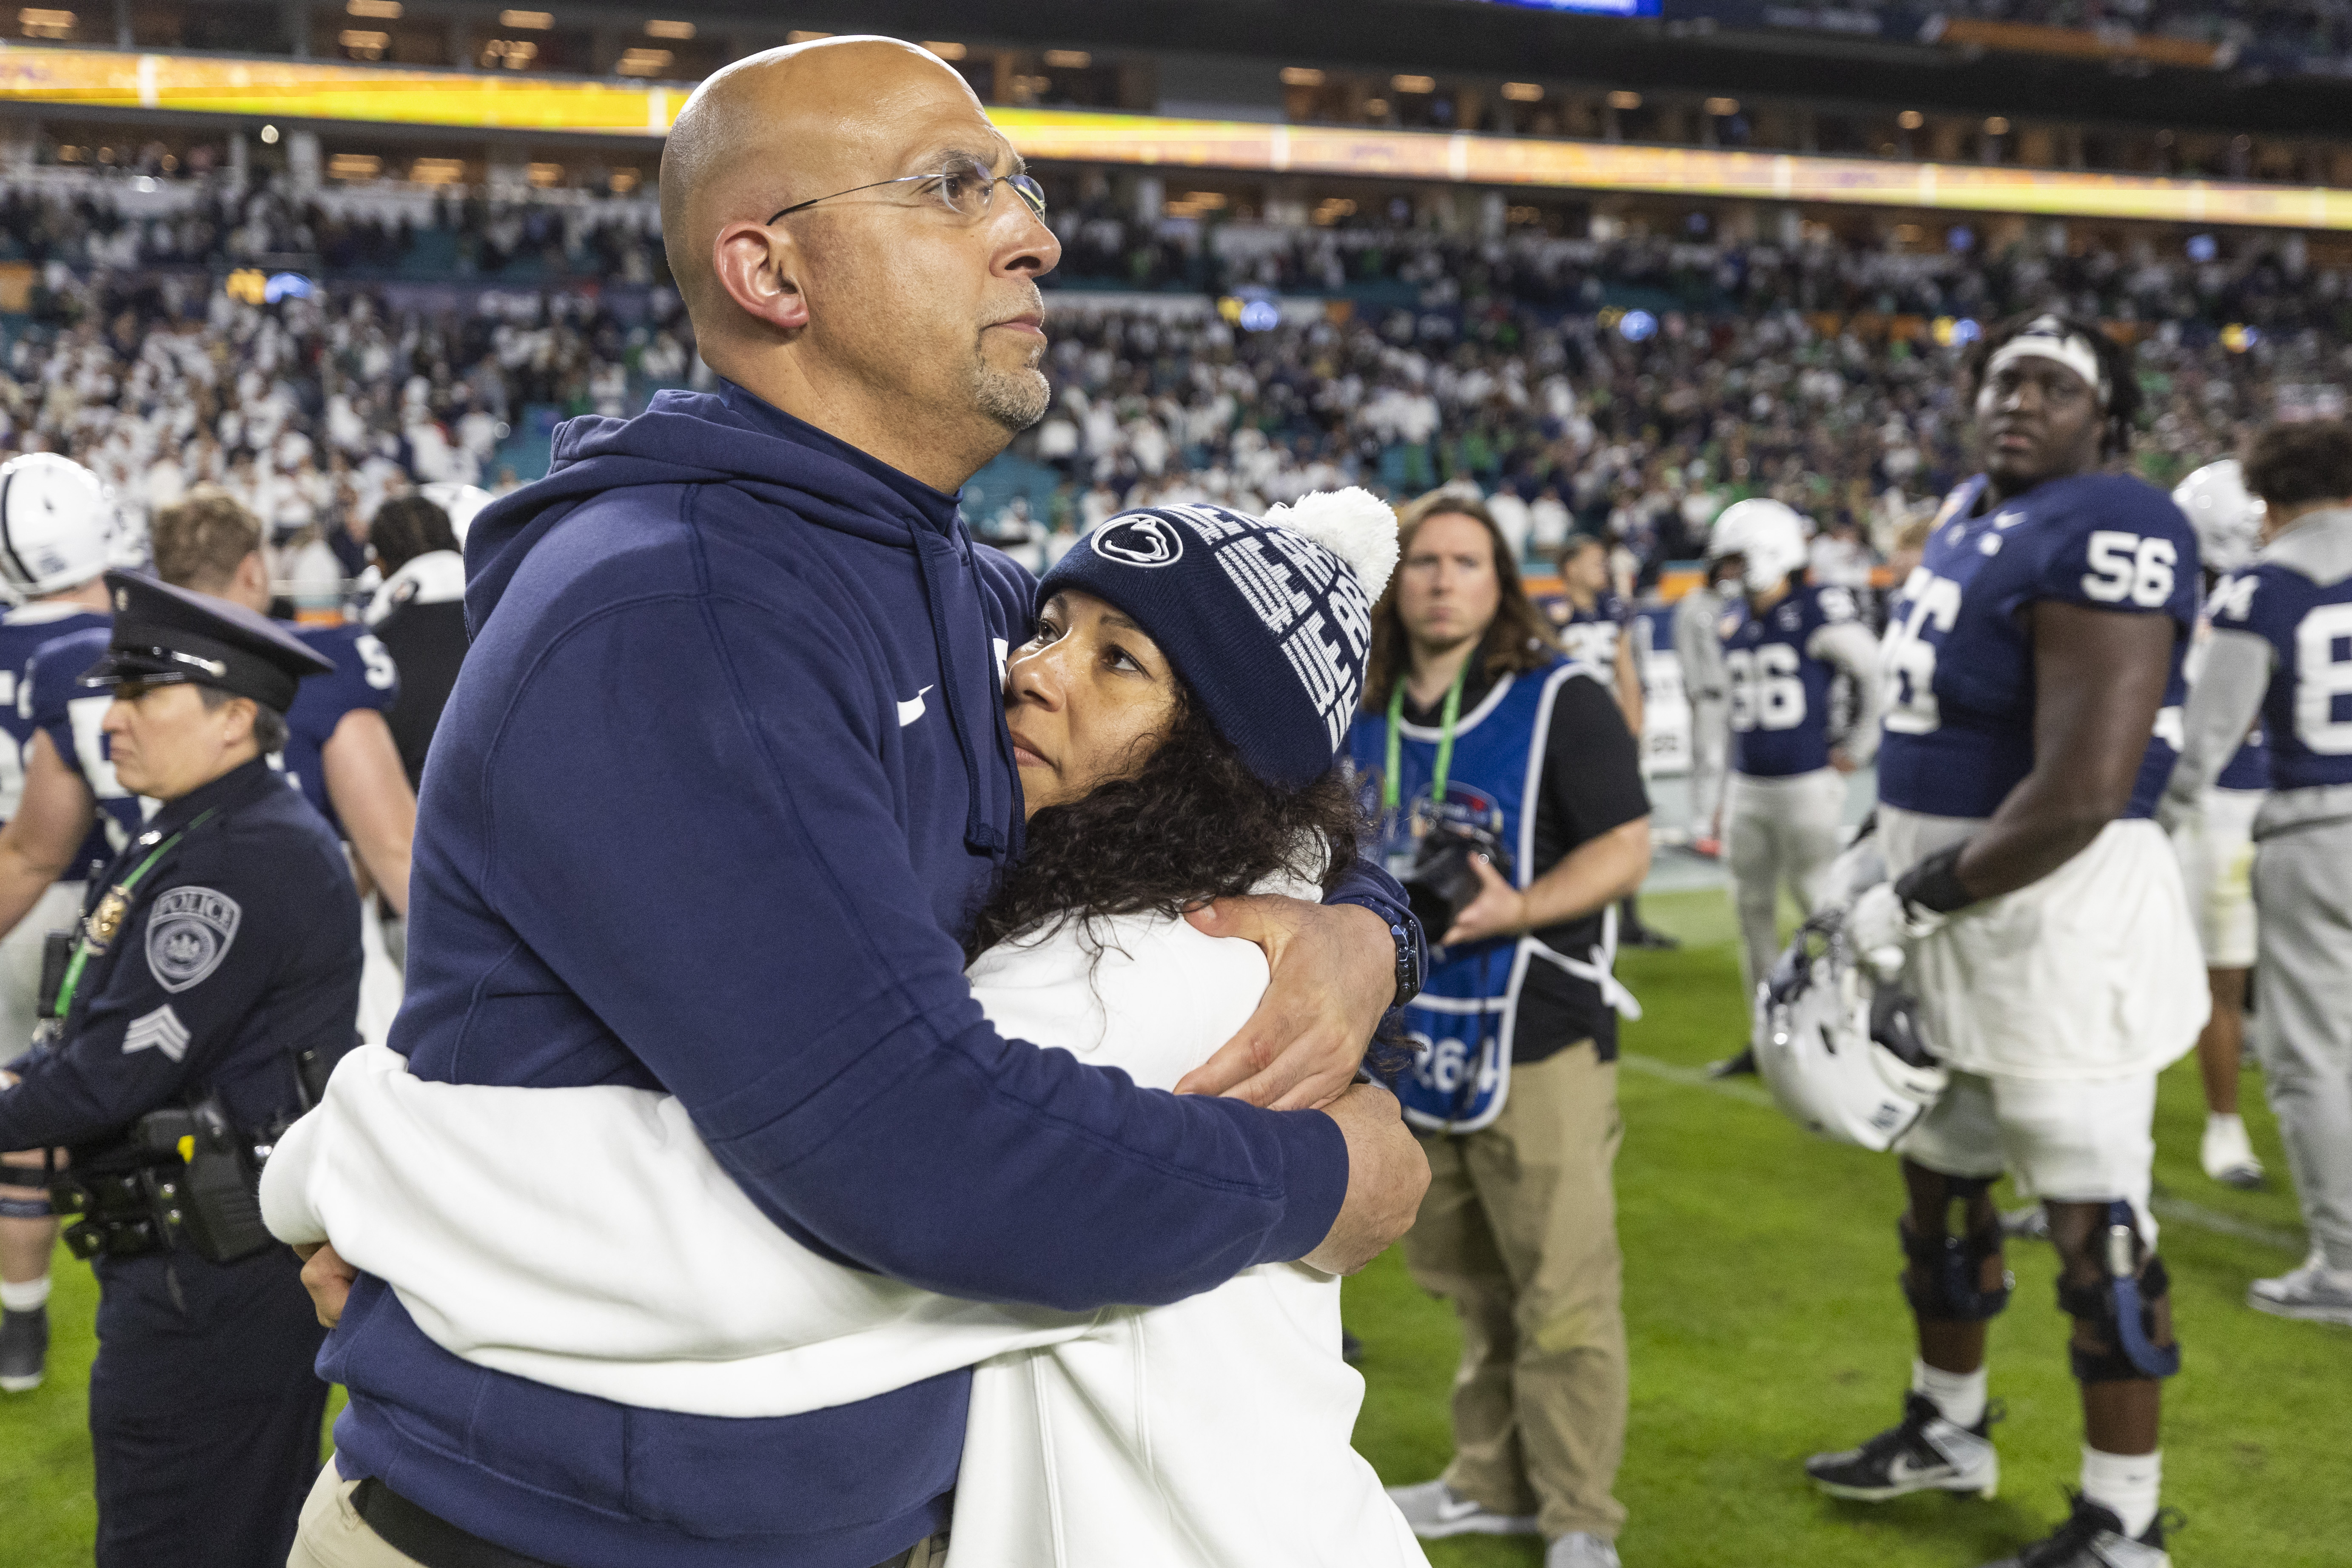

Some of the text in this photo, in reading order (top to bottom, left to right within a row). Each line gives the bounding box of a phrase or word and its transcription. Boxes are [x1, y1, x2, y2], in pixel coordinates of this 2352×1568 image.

[1214, 536, 1313, 635] WE
[2081, 530, 2178, 607] 56
[1280, 610, 1352, 716] WE
[153, 892, 236, 931] POLICE
